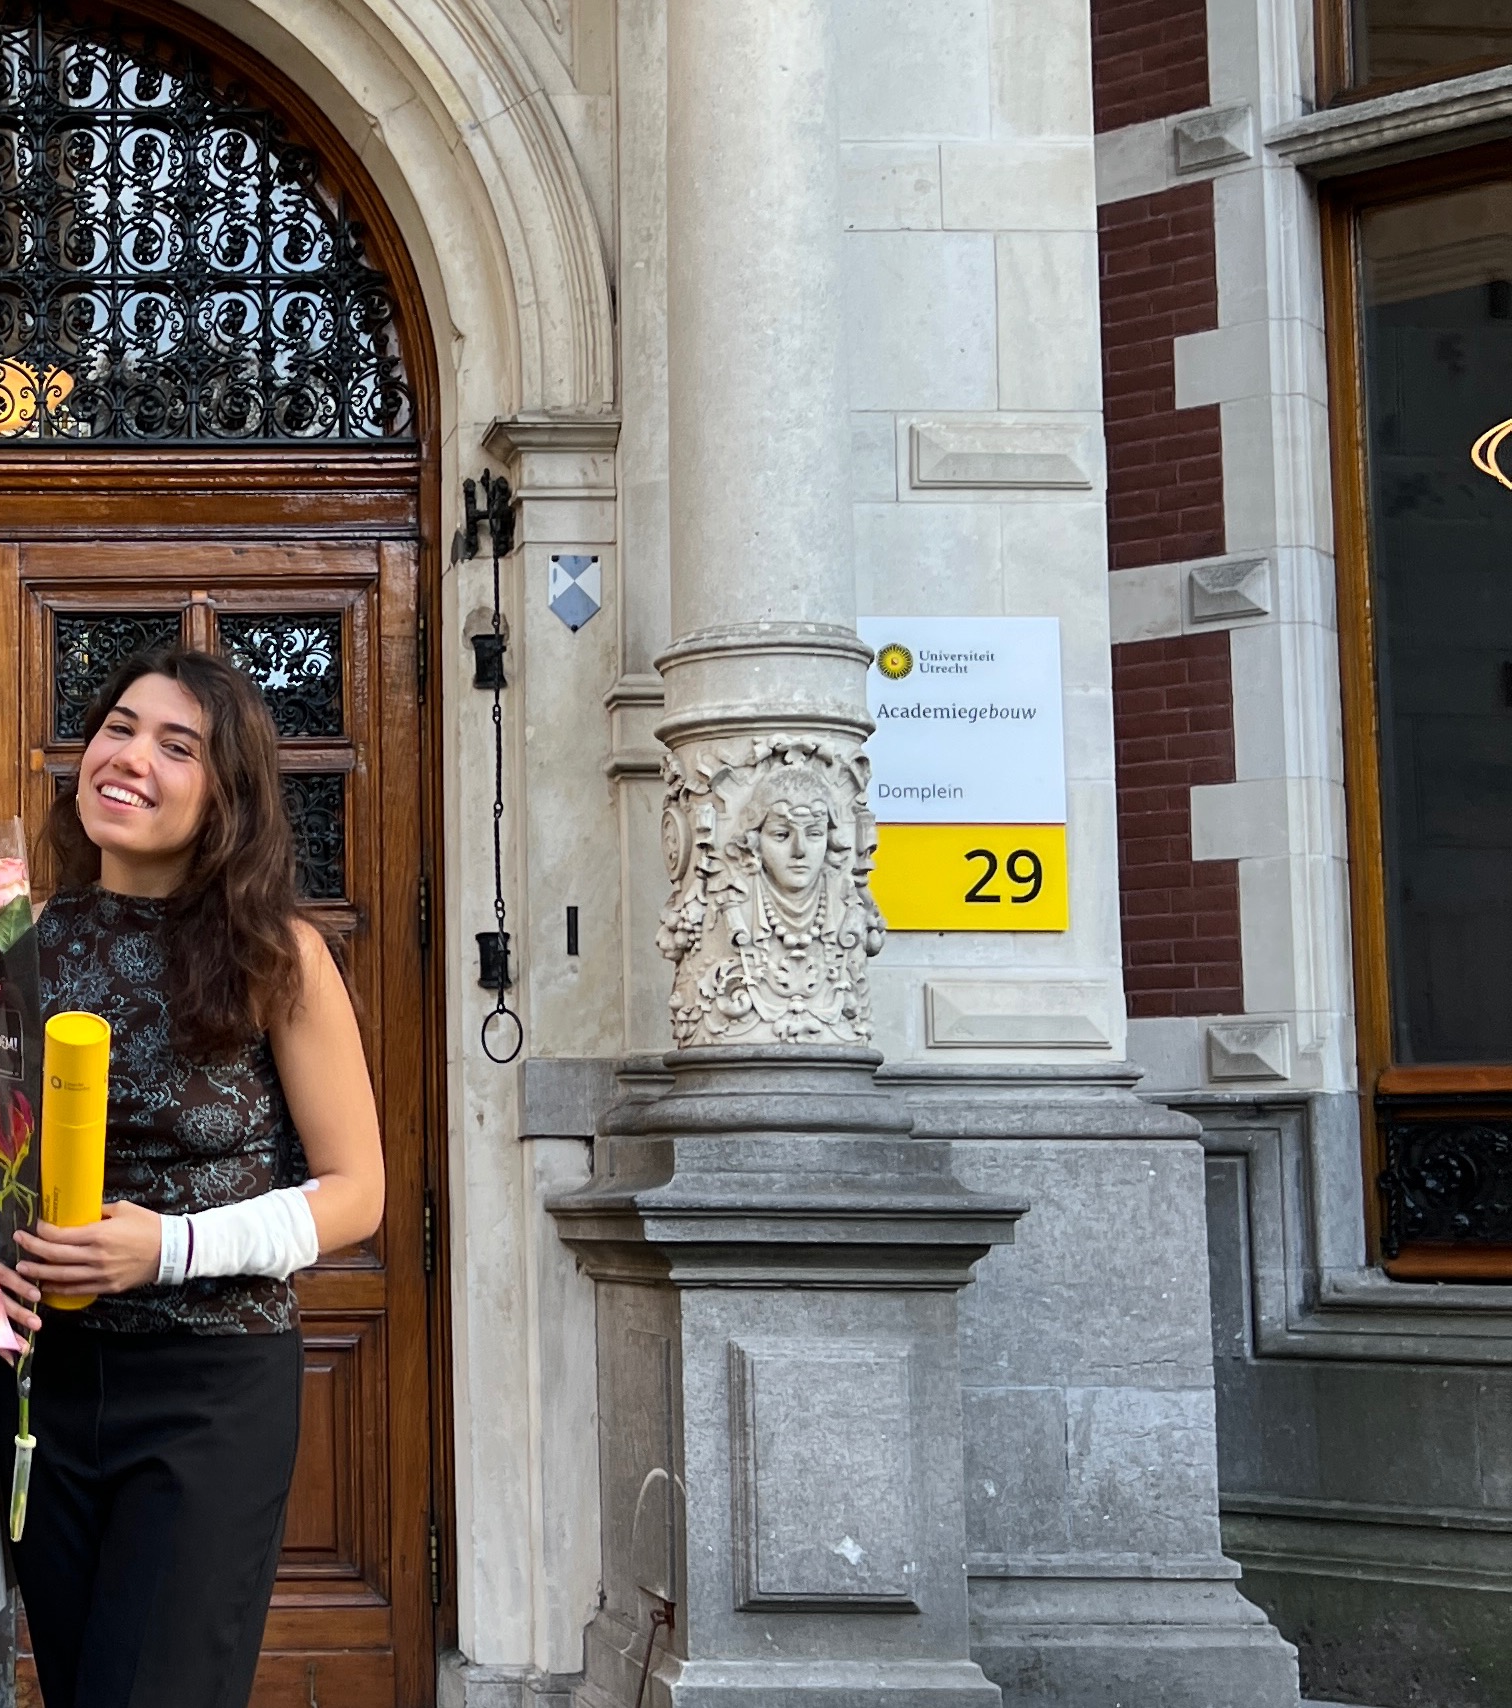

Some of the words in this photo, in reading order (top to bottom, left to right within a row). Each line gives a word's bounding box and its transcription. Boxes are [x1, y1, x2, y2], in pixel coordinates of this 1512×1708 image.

[919, 650, 995, 662] Universiteit
[919, 662, 968, 674] Utrecht
[877, 702, 1037, 724] Academiegebouw
[878, 783, 964, 802] Domplein
[964, 848, 1043, 904] 29
